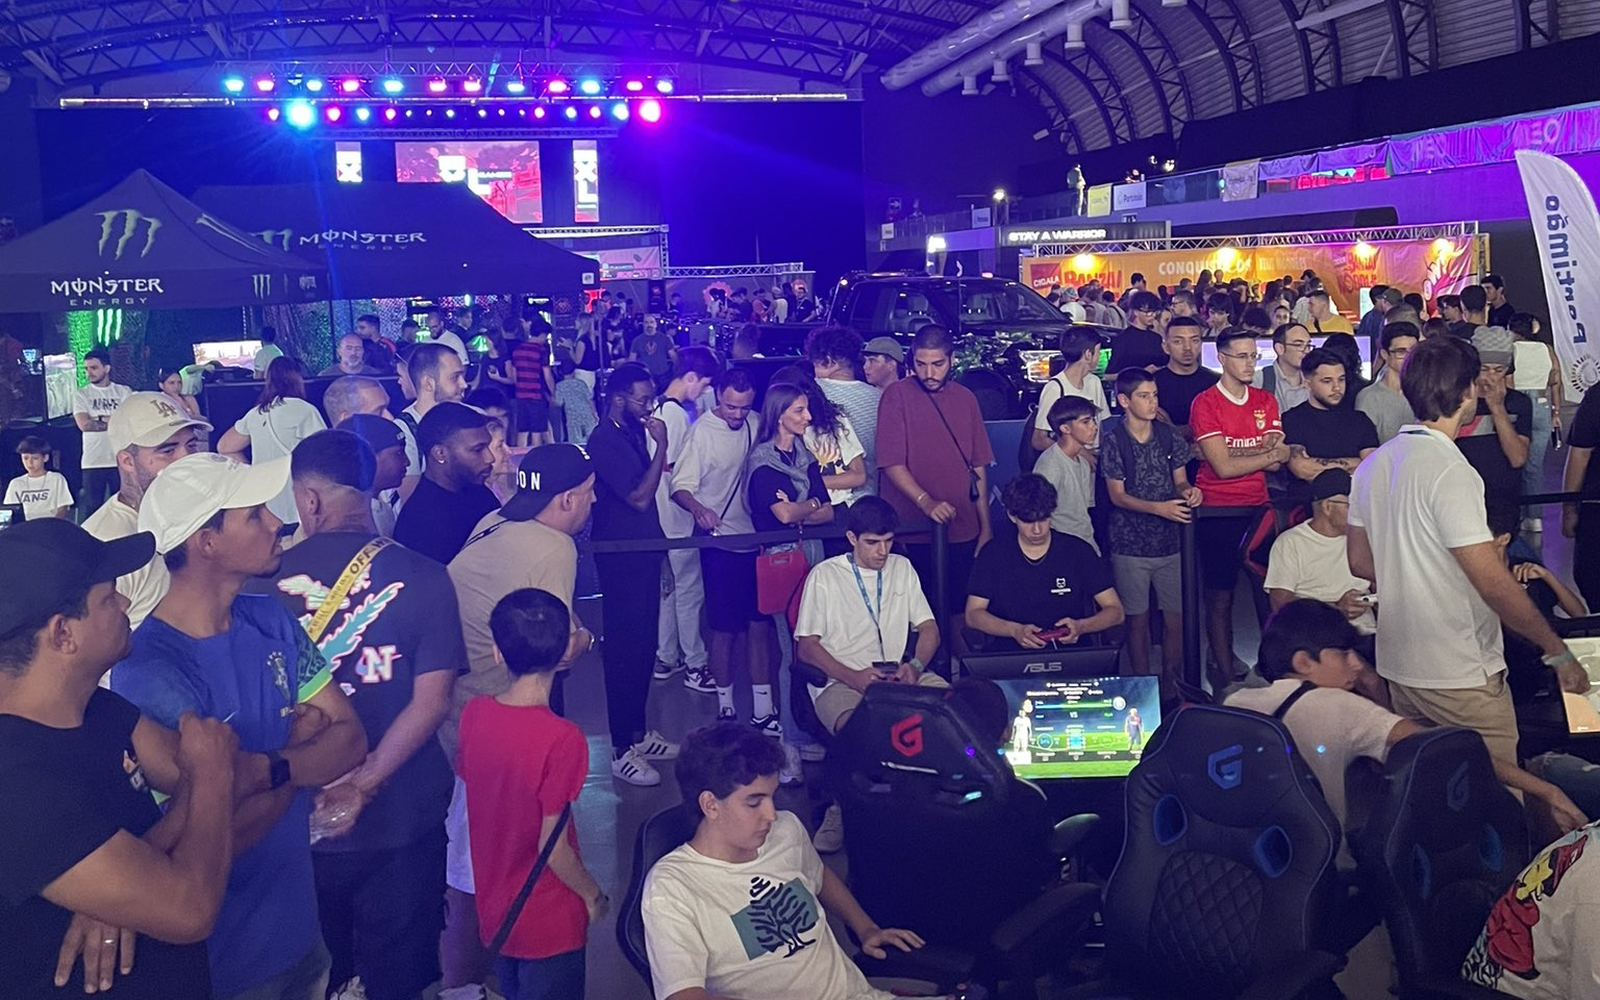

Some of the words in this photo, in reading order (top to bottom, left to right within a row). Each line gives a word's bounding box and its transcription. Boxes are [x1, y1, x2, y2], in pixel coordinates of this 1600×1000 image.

[299, 229, 428, 246] MONSTER
[1008, 231, 1040, 242] STAY
[1041, 230, 1051, 241] A
[1052, 228, 1107, 240] WARRIOR
[50, 276, 164, 297] MONSTER
[1033, 275, 1060, 287] CIGALA
[69, 297, 148, 306] ENERGY
[150, 399, 177, 417] LA
[1225, 436, 1262, 448] Emira
[15, 489, 50, 503] VANS
[1023, 661, 1063, 673] ASUS
